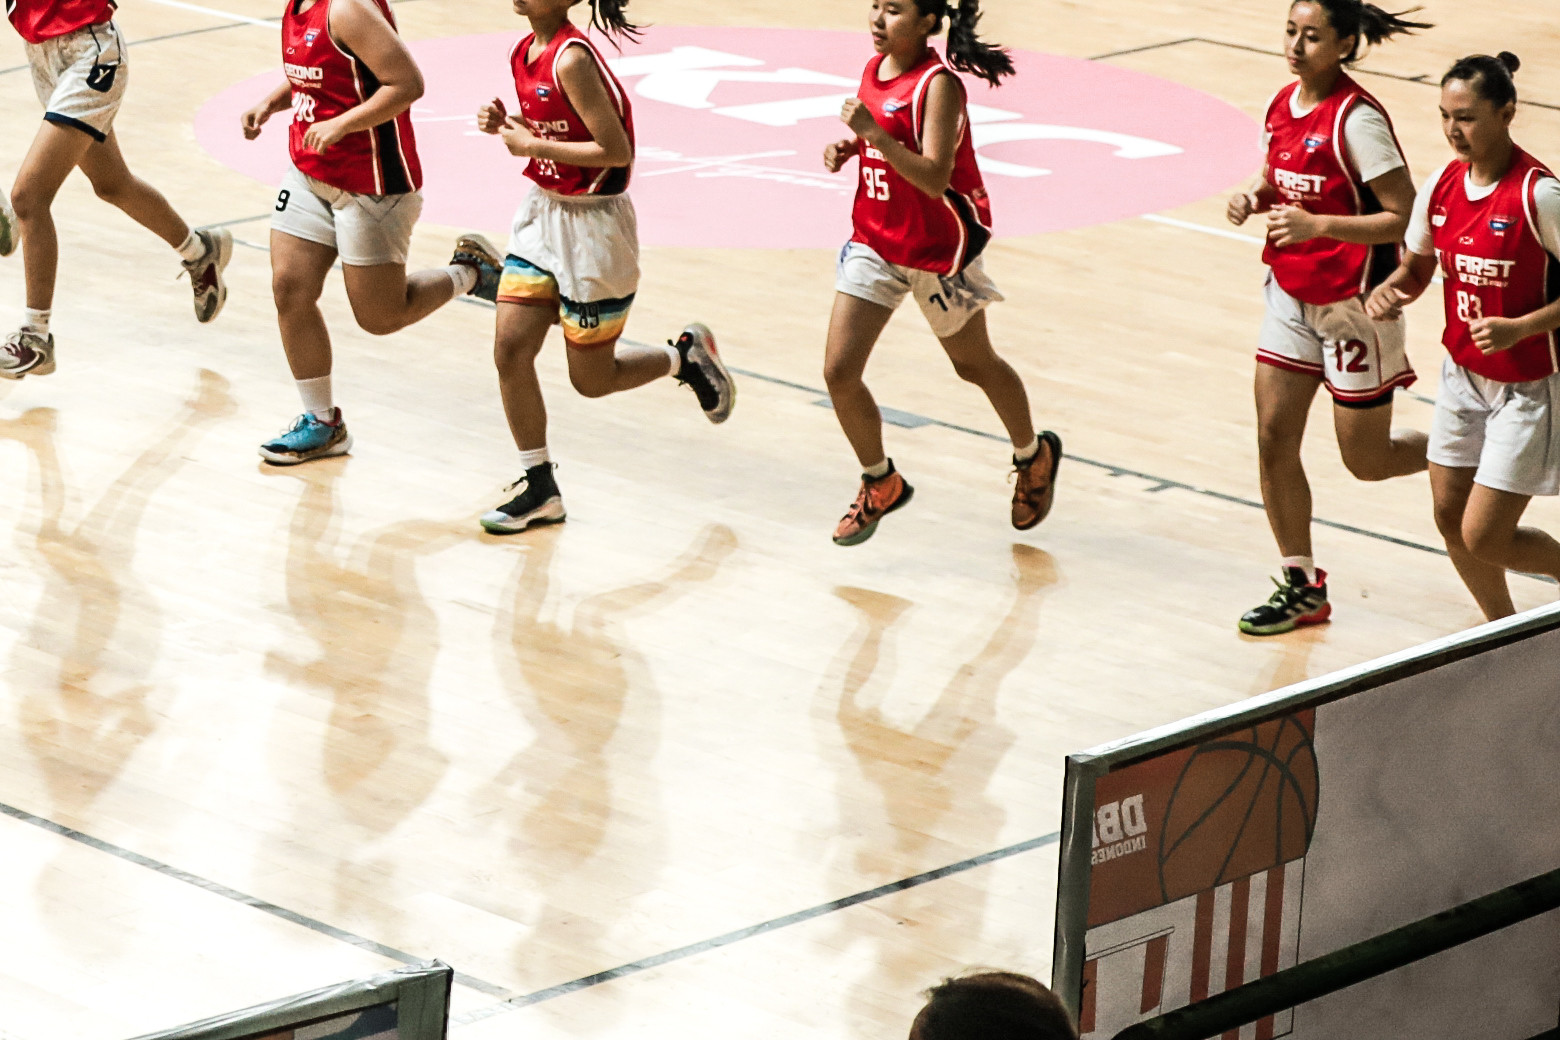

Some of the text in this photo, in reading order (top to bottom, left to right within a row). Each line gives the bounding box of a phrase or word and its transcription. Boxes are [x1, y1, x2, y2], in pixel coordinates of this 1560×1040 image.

[284, 63, 323, 80] SECOND
[862, 166, 890, 201] 95
[275, 189, 290, 212] 9
[1455, 253, 1516, 278] FIRST
[1334, 339, 1369, 372] 12
